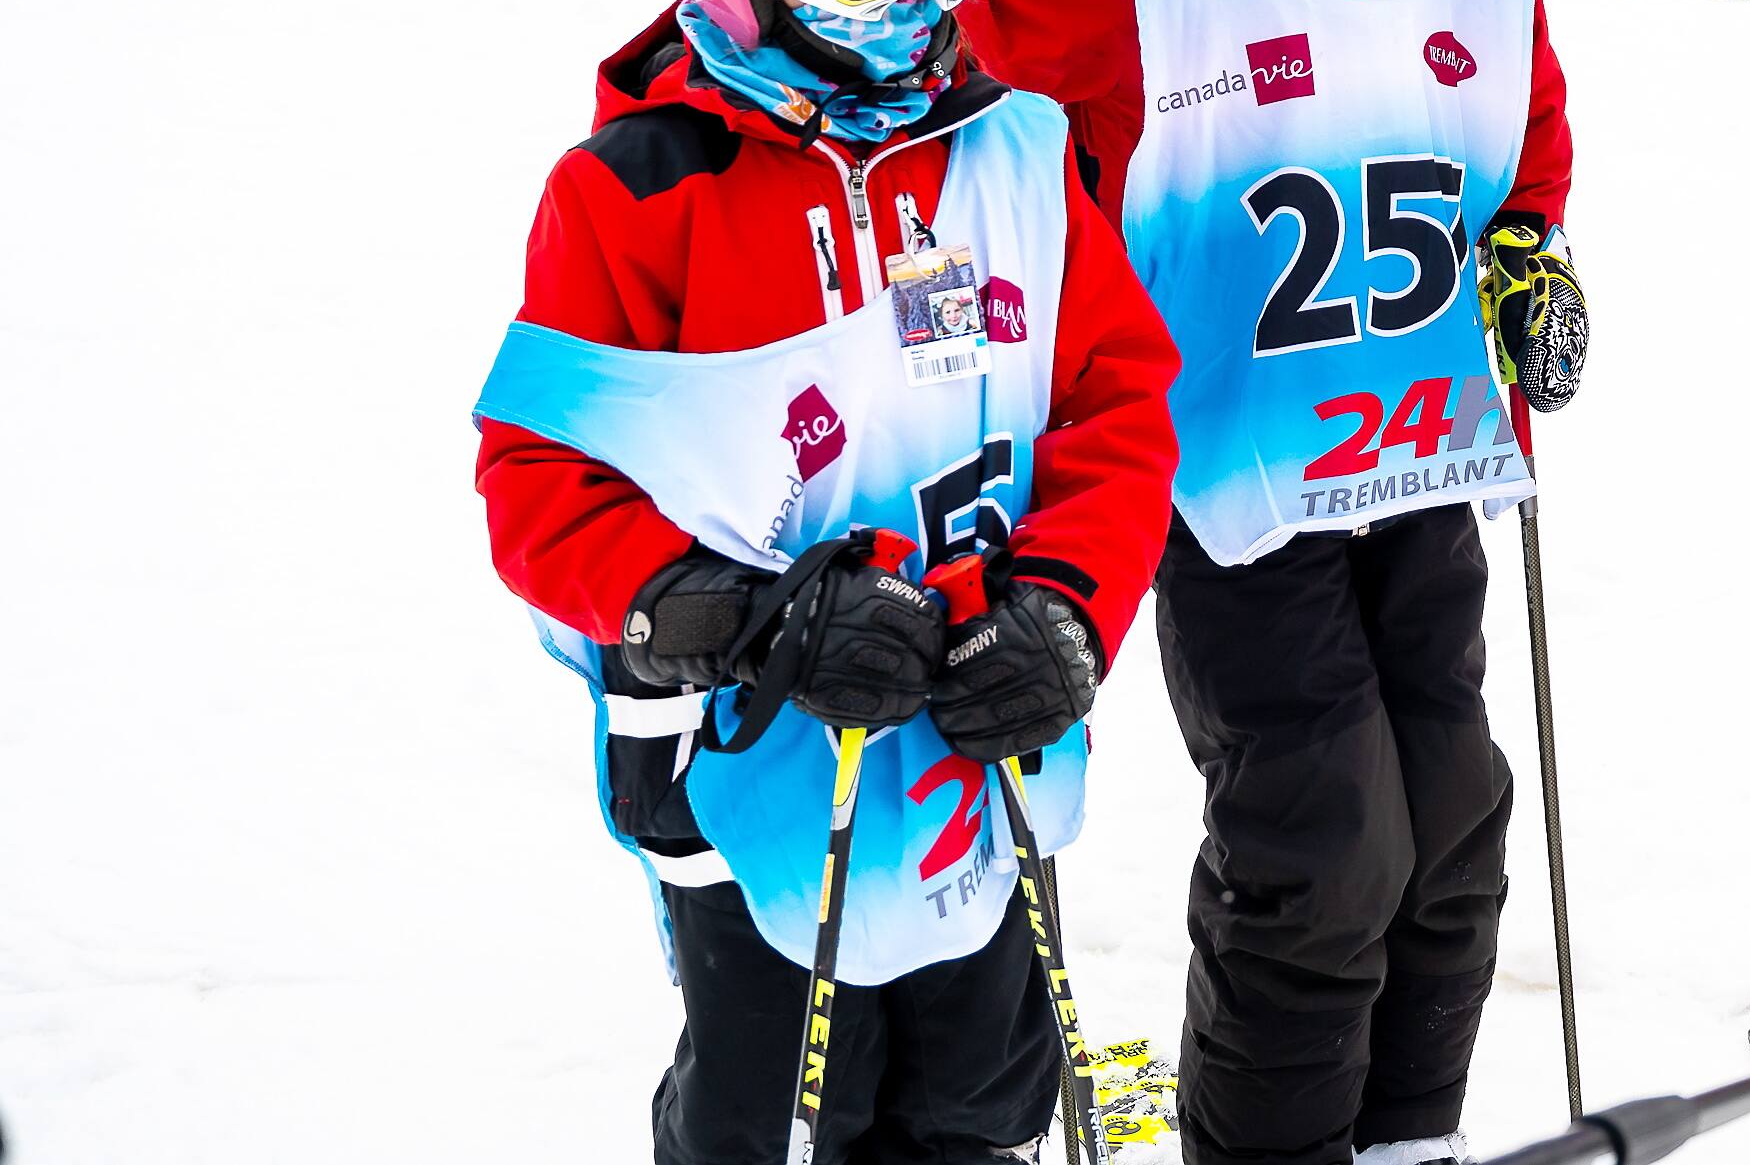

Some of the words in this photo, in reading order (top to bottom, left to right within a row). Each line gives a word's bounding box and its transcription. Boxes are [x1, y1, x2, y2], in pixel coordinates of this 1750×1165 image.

[1157, 69, 1248, 113] canada
[1250, 55, 1313, 85] vie
[792, 415, 842, 460] vie
[1303, 375, 1515, 481] 24h
[1300, 452, 1514, 517] TREMBLANT
[876, 576, 929, 608] SWANY
[946, 625, 998, 667] SWANY
[905, 753, 989, 882] 2
[926, 833, 995, 919] TREM
[801, 977, 836, 1111] LEKI
[1049, 968, 1093, 1078] LEKI
